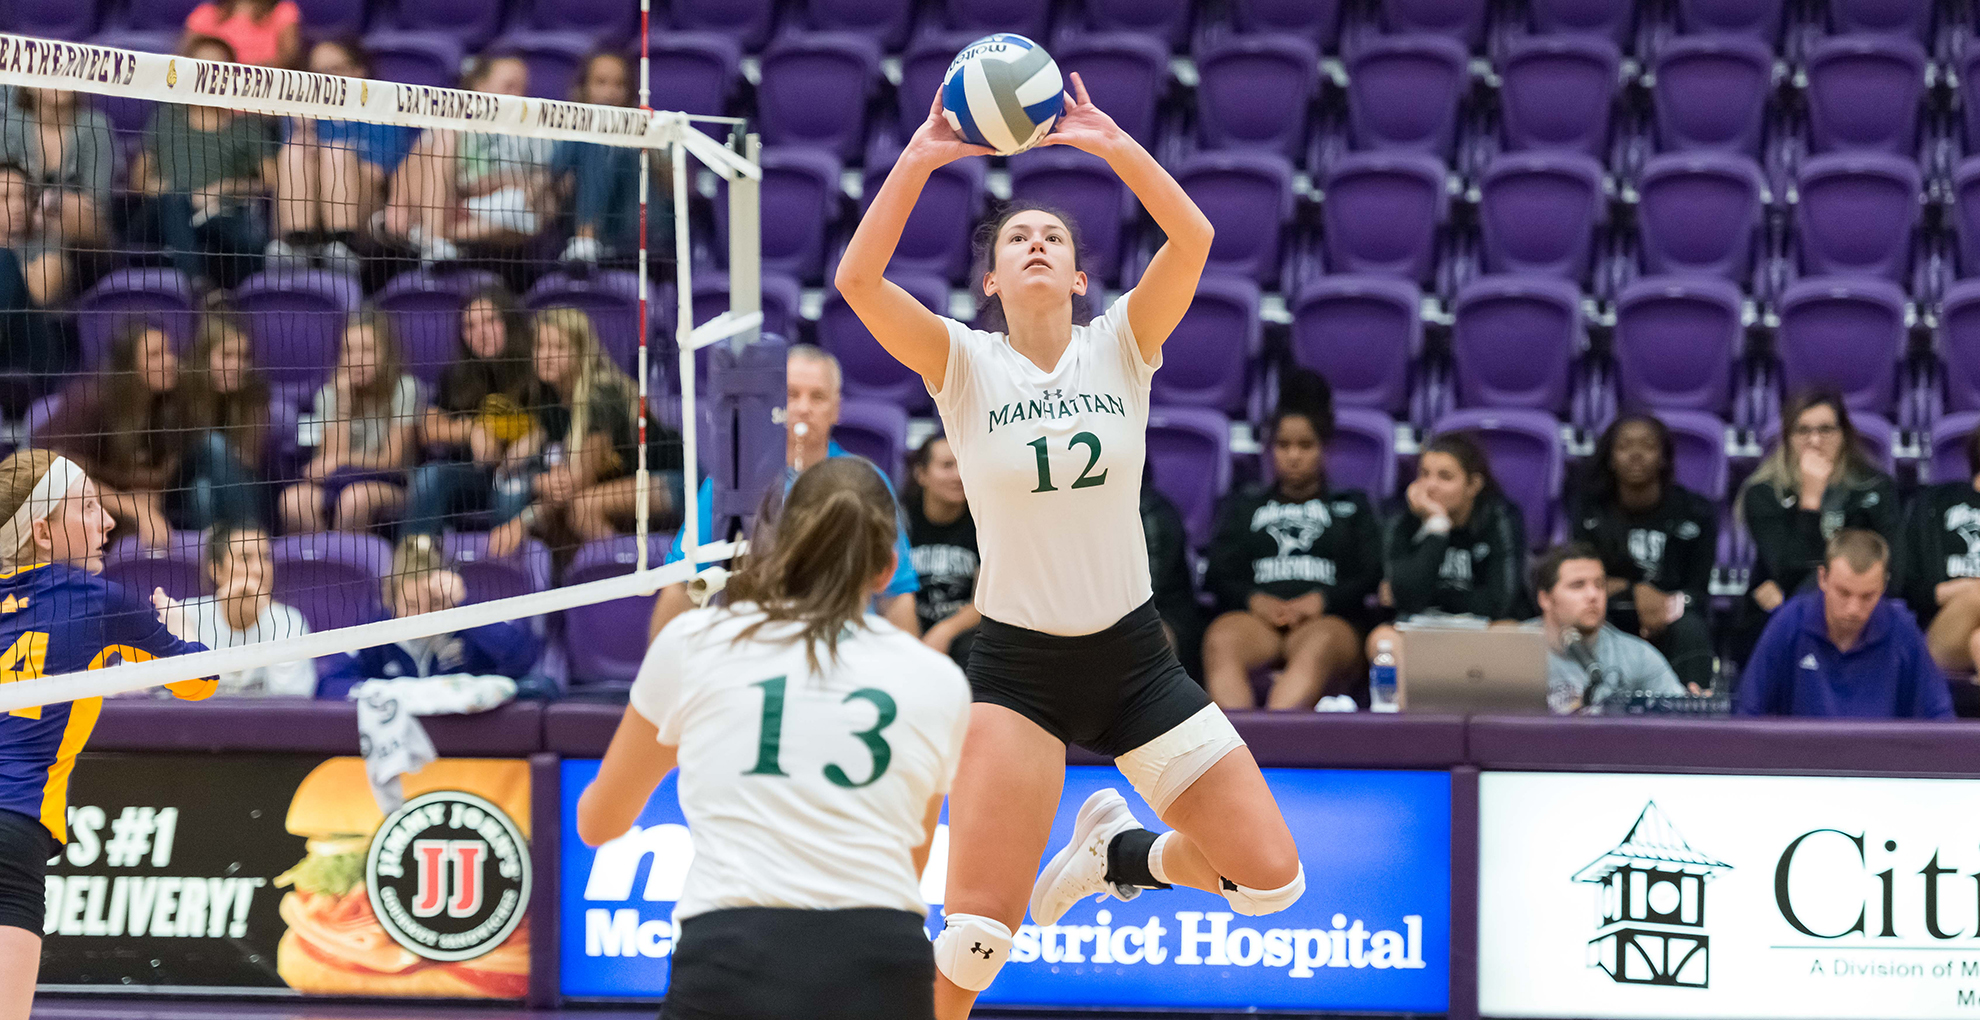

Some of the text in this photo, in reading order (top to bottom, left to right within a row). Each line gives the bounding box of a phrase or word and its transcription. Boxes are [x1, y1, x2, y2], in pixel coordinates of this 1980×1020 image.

[0, 37, 136, 86] EATHERNECKS
[194, 62, 274, 99] WESTERN
[277, 70, 347, 107] ILLINOIS
[988, 393, 1126, 434] MANHATTAN
[1026, 431, 1108, 493] 12
[740, 675, 898, 789] 13
[105, 806, 179, 867] #1
[377, 802, 446, 879] JIMMY
[43, 874, 255, 938] DELIVERY!
[412, 839, 488, 918] JJ
[1009, 909, 1168, 965] strict
[1174, 911, 1426, 978] Hospital
[1810, 958, 1980, 977] A Division of M
[1957, 990, 1980, 1007] M
